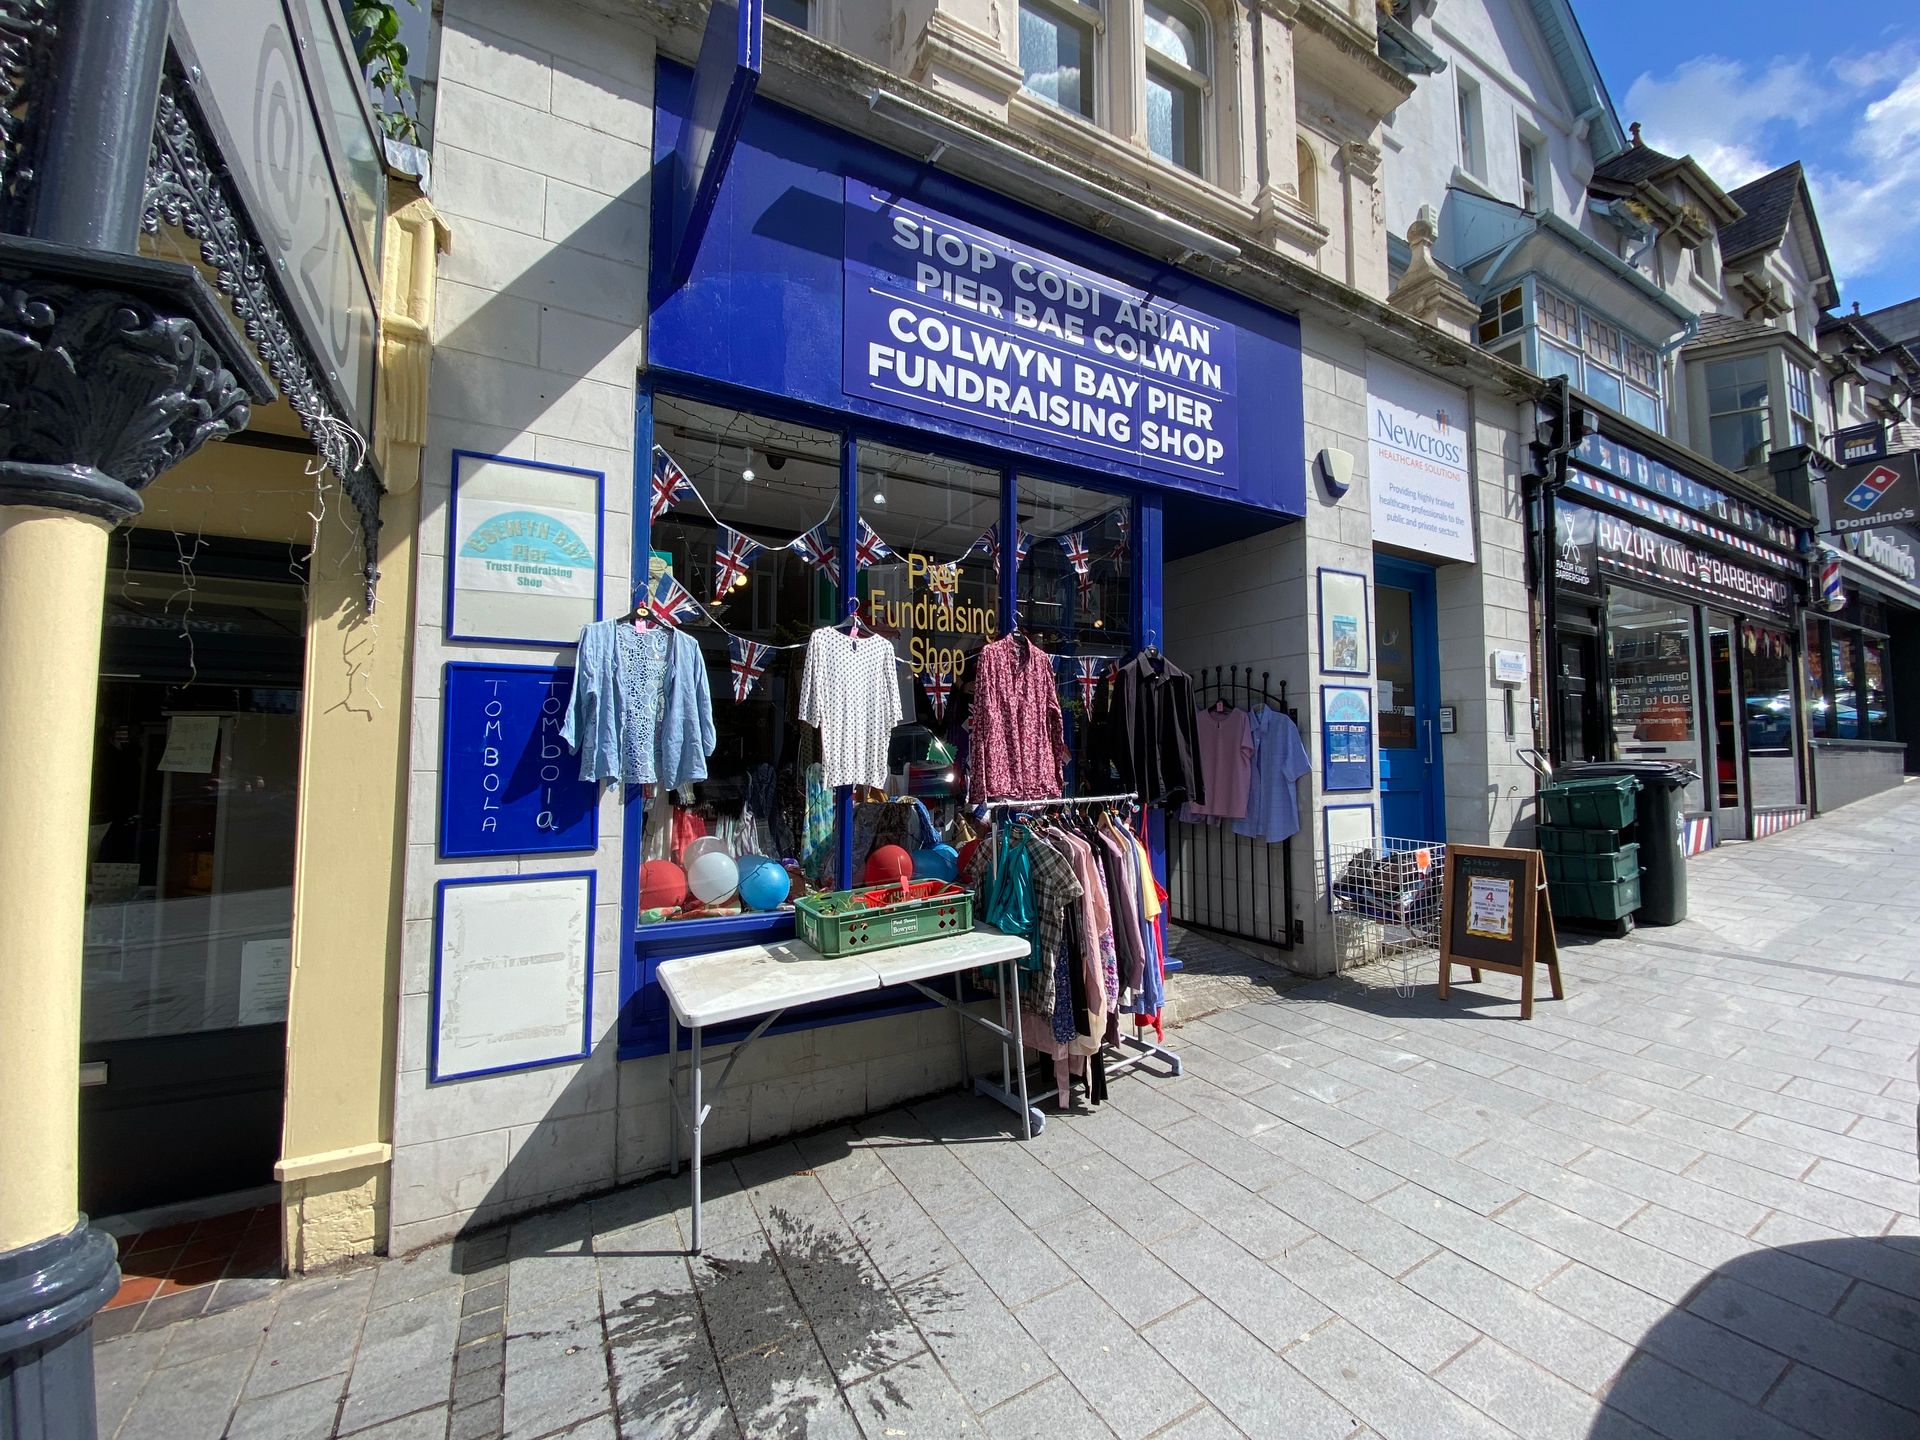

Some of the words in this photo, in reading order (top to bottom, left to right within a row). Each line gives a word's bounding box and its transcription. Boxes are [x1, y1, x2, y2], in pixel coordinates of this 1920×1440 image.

[892, 216, 997, 275] SIOP
[1011, 261, 1100, 316] CODI
[1115, 300, 1210, 354] ARIAN
[916, 261, 1004, 320] PIER
[1014, 297, 1084, 345] BAE
[1094, 326, 1222, 390] COLWYN
[888, 308, 1061, 387] COLWYN
[1074, 363, 1140, 408] BAY
[1148, 387, 1213, 431] PIER
[868, 342, 1131, 443] FUNDRAISING
[1141, 420, 1224, 464] SHOP
[1377, 409, 1460, 464] Newcross
[1844, 443, 1877, 460] HILL
[1379, 447, 1423, 470] HEALTHCARE
[1425, 463, 1461, 482] SOLUTIONS
[1379, 494, 1410, 511] healthcare
[1412, 504, 1447, 521] professionals
[1448, 514, 1455, 523] to
[1456, 516, 1465, 526] the
[1389, 482, 1416, 501] Providing
[1418, 491, 1434, 505] highly
[1436, 497, 1455, 510] trained
[1386, 513, 1405, 525] public
[1406, 517, 1417, 527] and
[1418, 521, 1438, 533] private
[1835, 507, 1915, 531] Domino's
[511, 543, 547, 562] Pier
[552, 529, 592, 561] BAY
[485, 560, 512, 572] Trust
[514, 563, 573, 578] Fundraising
[908, 553, 964, 594] Pier
[1555, 559, 1574, 572] RAZOR
[1574, 564, 1588, 575] KING
[1555, 568, 1590, 585] BARBERSHOP
[1599, 521, 1656, 564] RAZOR
[1660, 543, 1696, 577] KING
[1713, 559, 1787, 604] BARBERSHOP
[517, 576, 543, 587] Shop
[871, 589, 997, 644] Fundraising
[909, 636, 966, 683] Shop
[481, 679, 508, 833] TOMBOLA
[1485, 891, 1495, 903] 4
[893, 925, 916, 934] Bowyers
